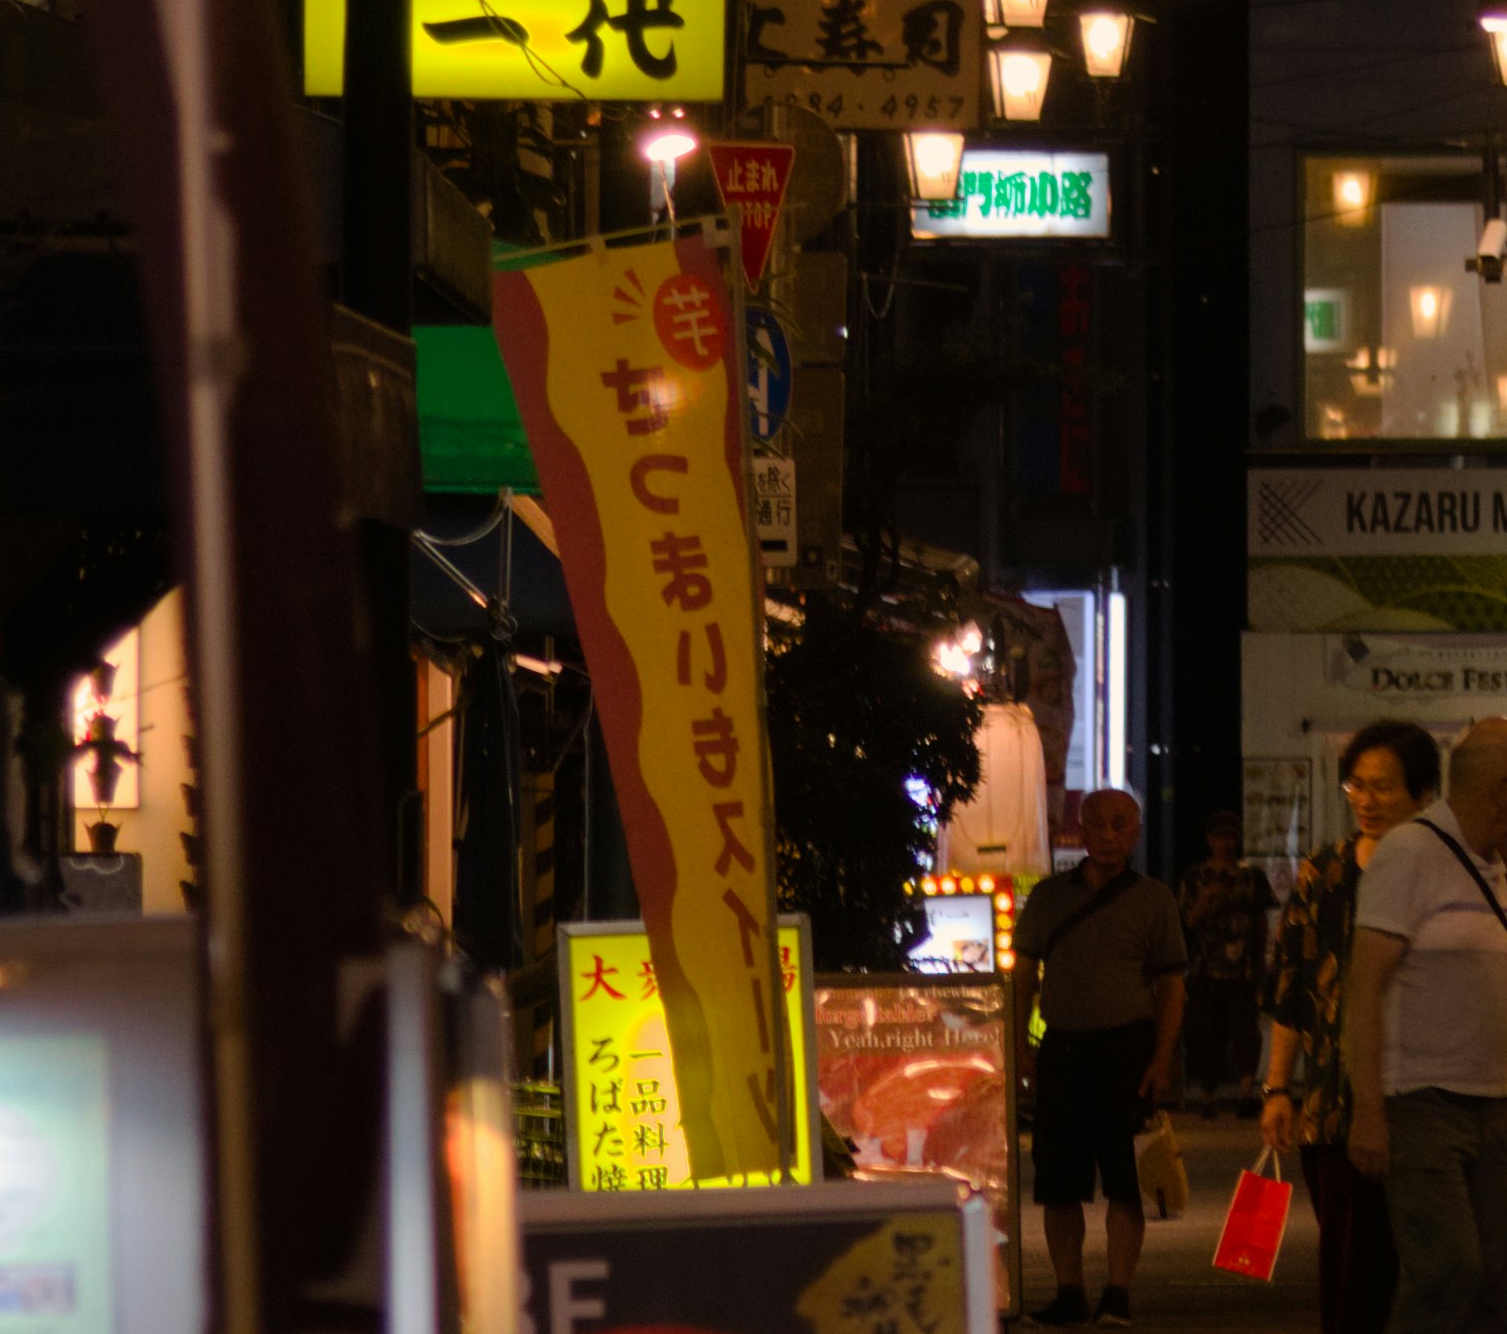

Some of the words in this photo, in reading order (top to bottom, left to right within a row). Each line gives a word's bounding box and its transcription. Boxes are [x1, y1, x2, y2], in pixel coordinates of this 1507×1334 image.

[726, 159, 779, 192] 止まれ
[1346, 491, 1481, 534] KAZARU
